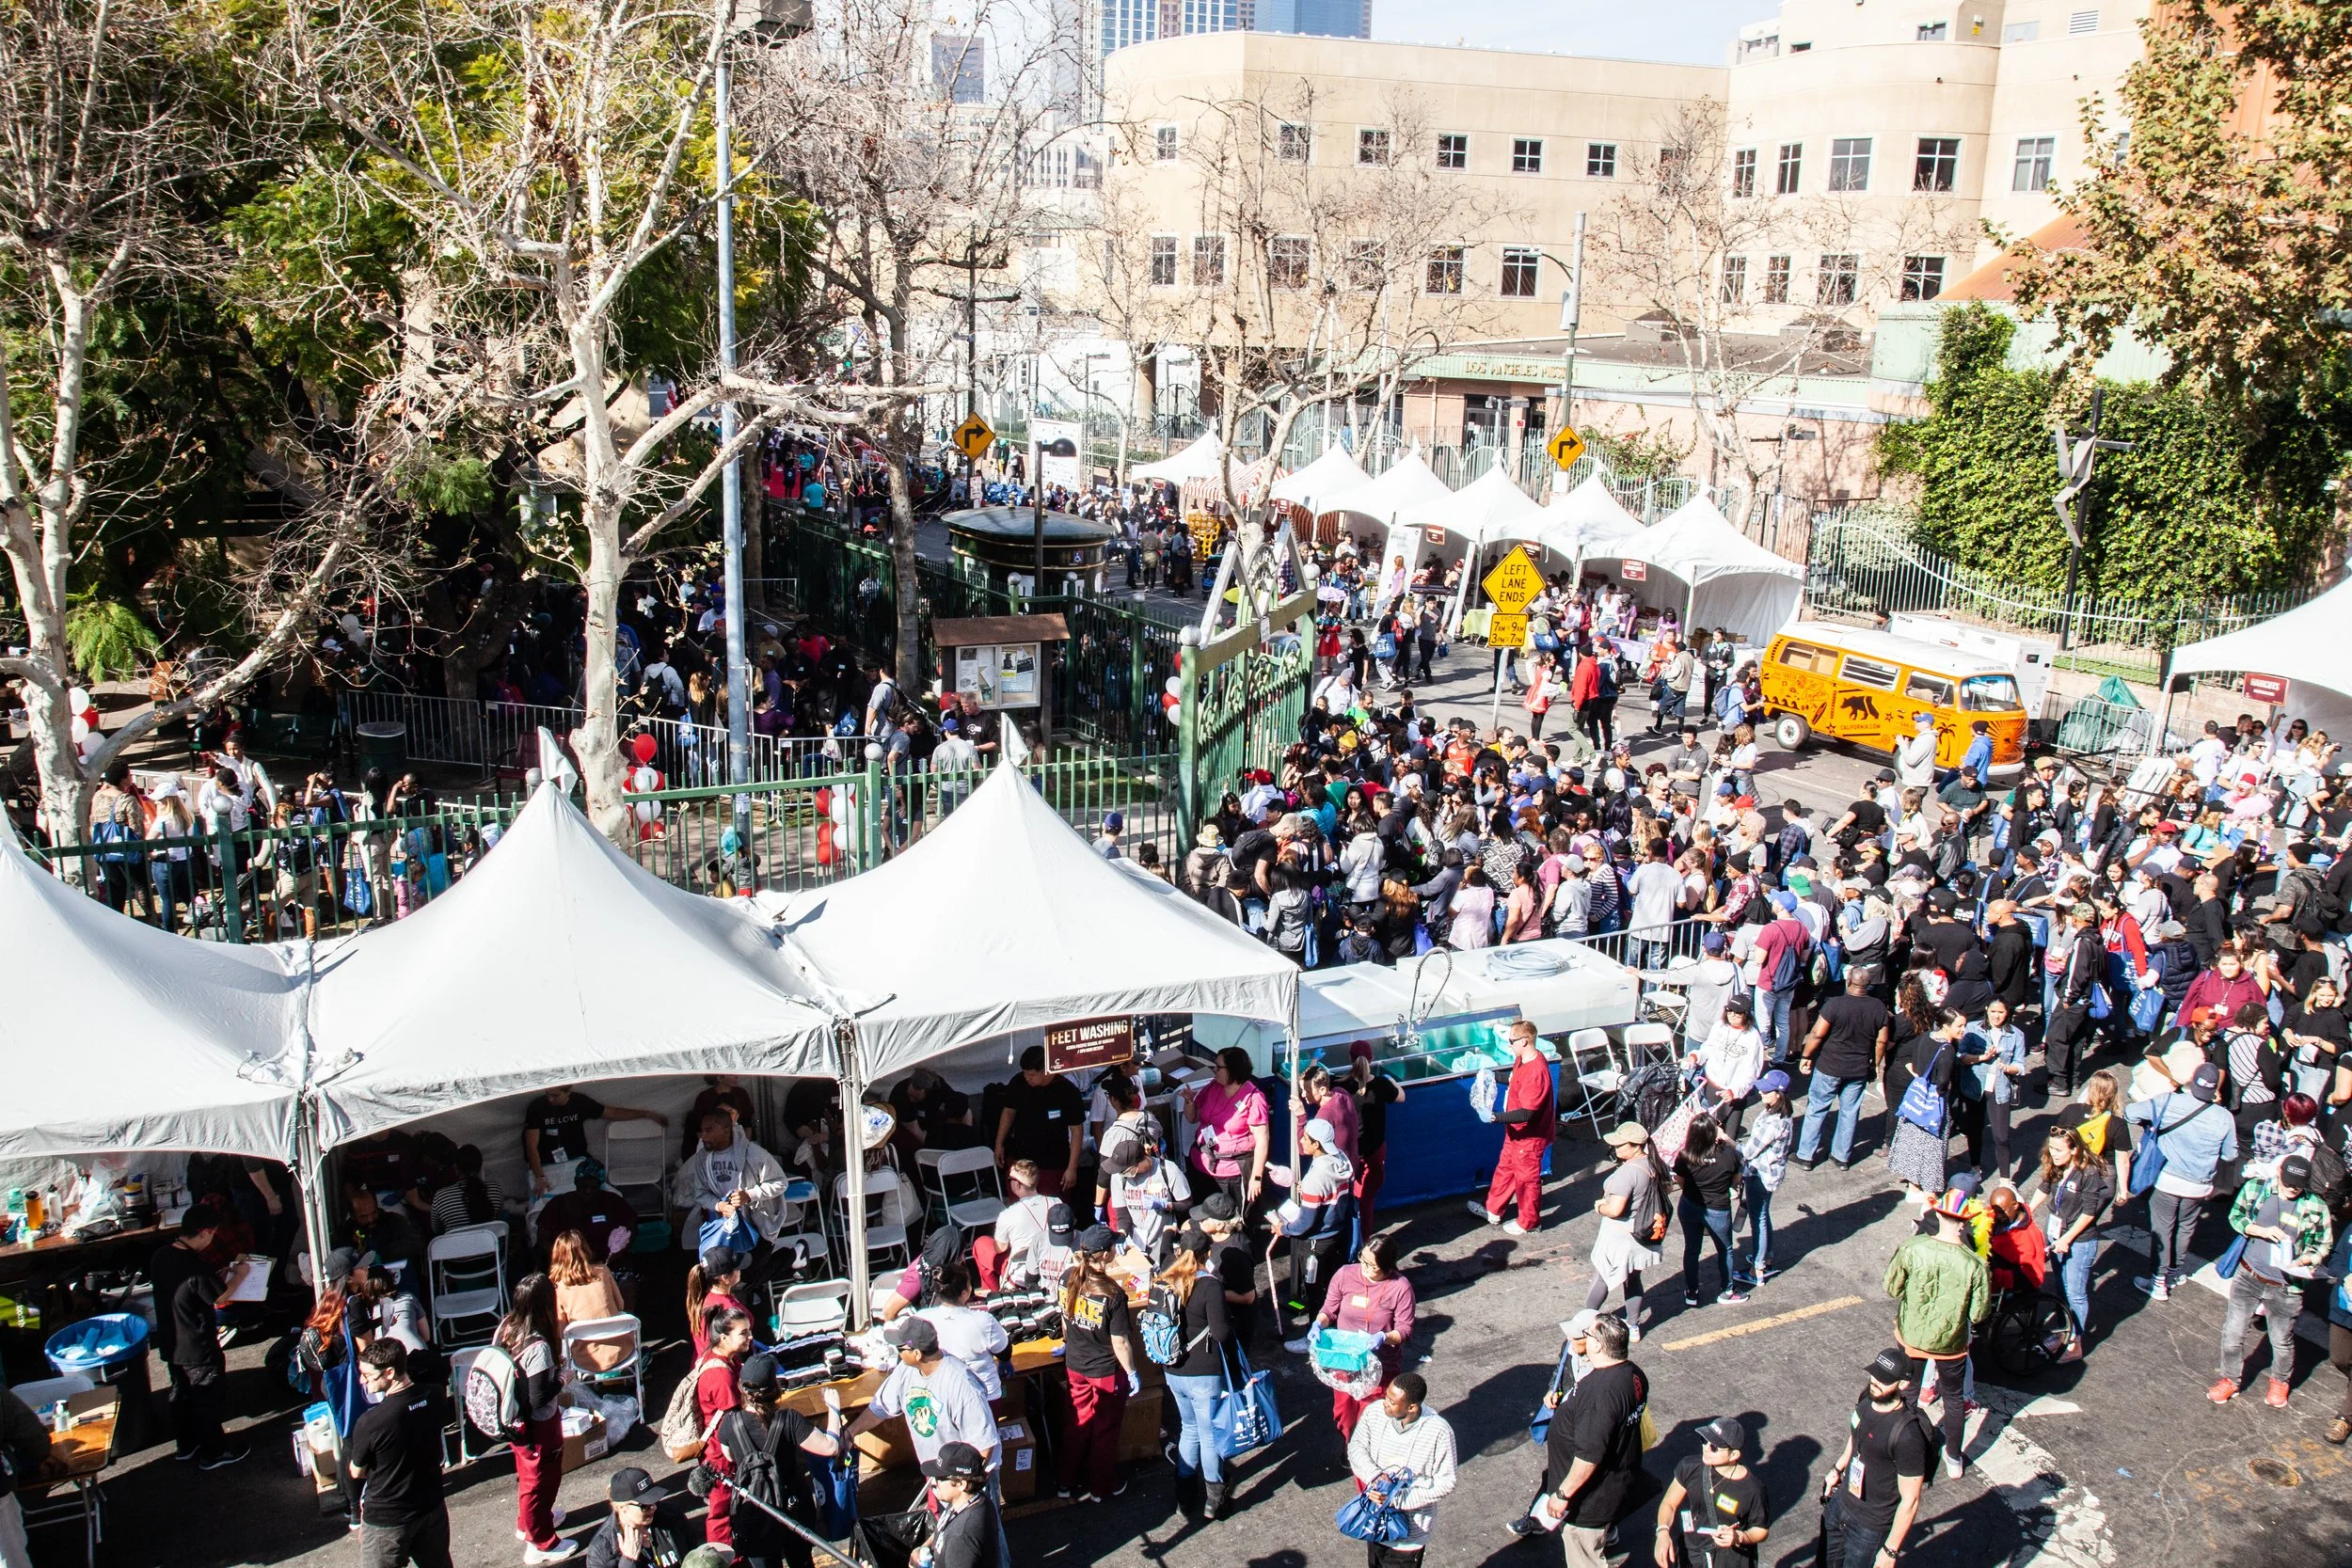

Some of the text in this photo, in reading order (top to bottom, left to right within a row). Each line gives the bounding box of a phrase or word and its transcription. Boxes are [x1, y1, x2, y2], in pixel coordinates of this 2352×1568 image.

[1465, 361, 1486, 374] LOS
[1491, 363, 1537, 377] ANGELES
[1504, 564, 1528, 575] LEFT
[1502, 578, 1527, 589] LANE
[1500, 592, 1525, 602] ENDS
[1051, 1020, 1128, 1046] FEET WASHING
[558, 1114, 579, 1124] LOVE
